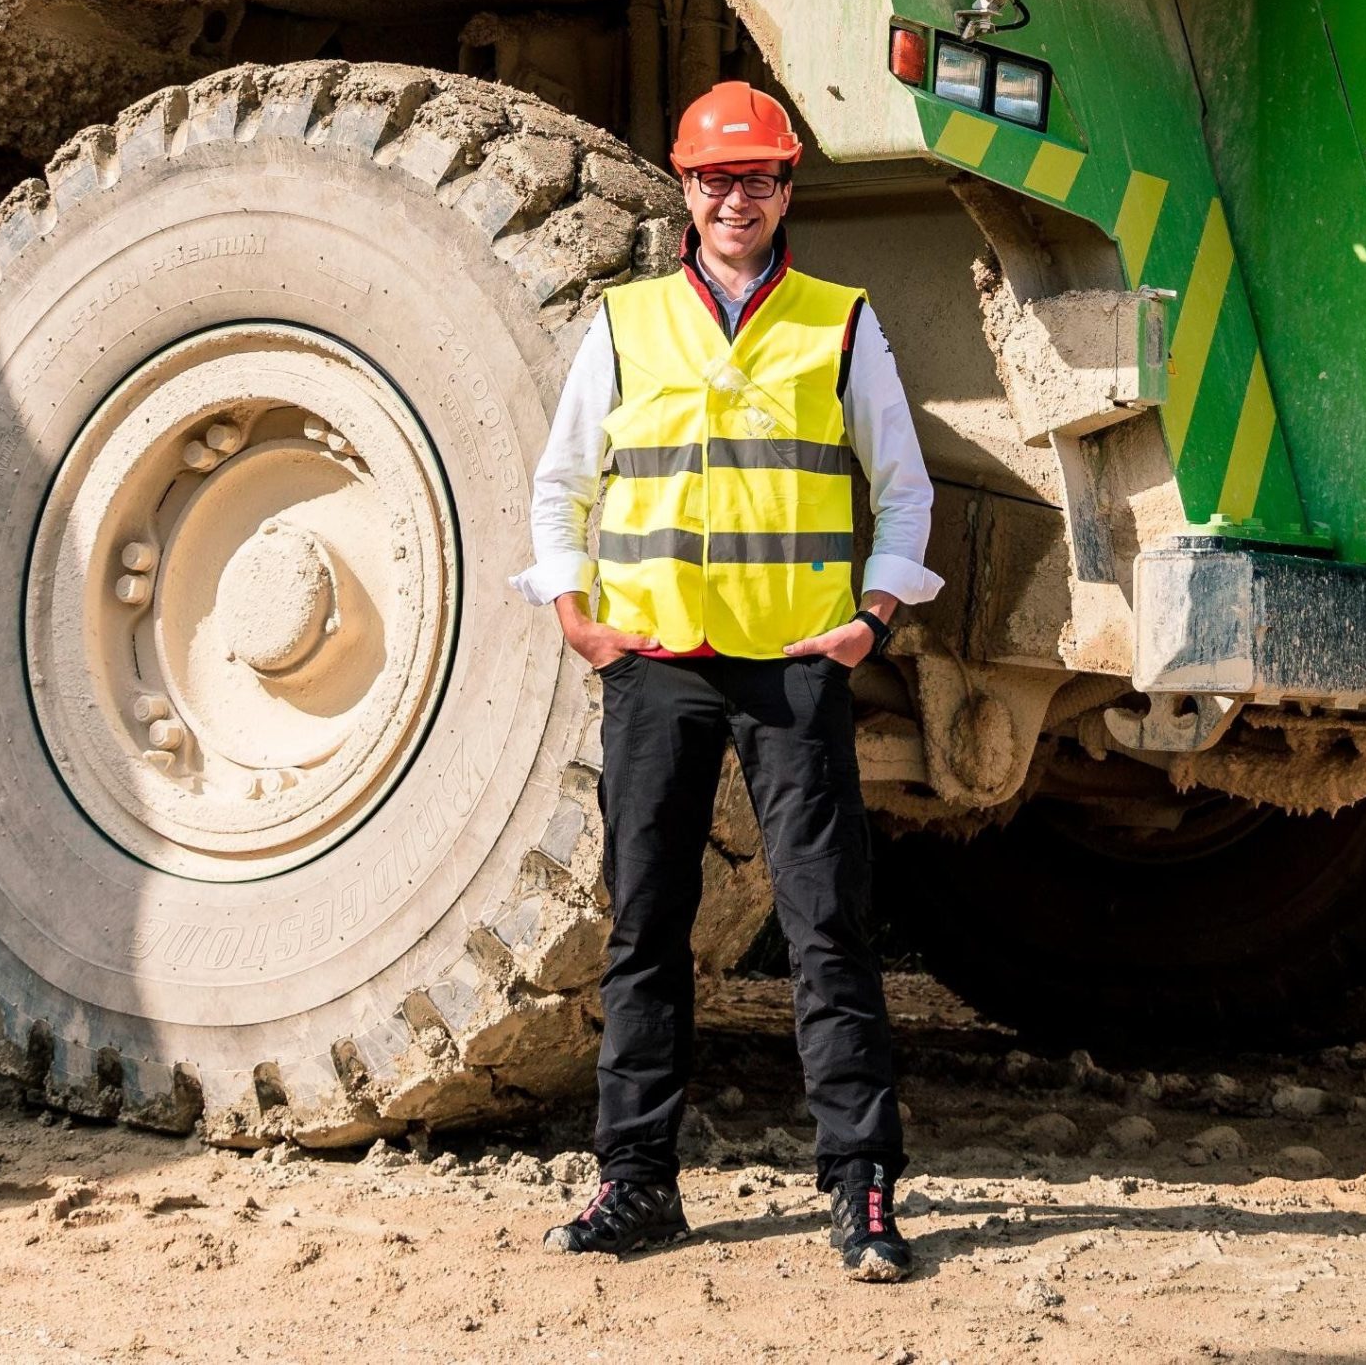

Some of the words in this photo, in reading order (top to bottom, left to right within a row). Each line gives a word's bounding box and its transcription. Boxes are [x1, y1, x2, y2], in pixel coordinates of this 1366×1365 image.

[145, 234, 267, 281] PREMIUM
[431, 314, 528, 526] 24.00R35
[123, 736, 486, 970] BRIDGESTONE
